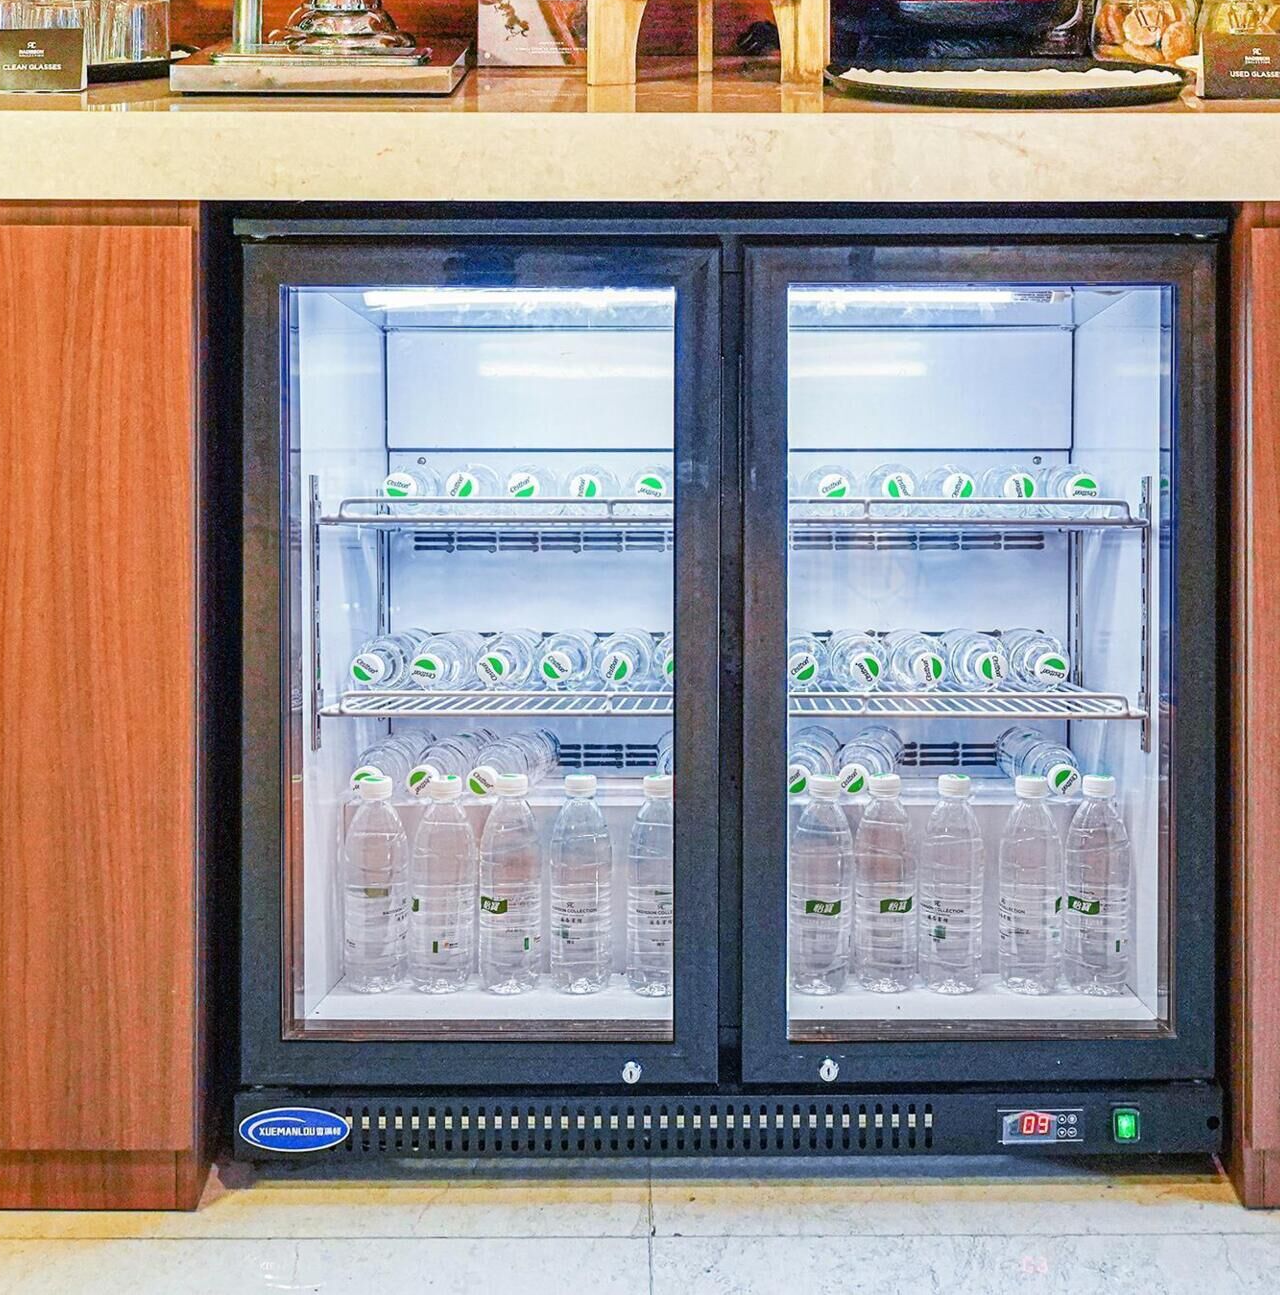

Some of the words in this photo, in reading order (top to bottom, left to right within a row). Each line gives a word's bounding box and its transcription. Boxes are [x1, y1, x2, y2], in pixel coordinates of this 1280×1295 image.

[1229, 70, 1250, 78] USED
[1022, 1115, 1049, 1134] 09
[259, 1127, 316, 1137] XUEMANLOU
